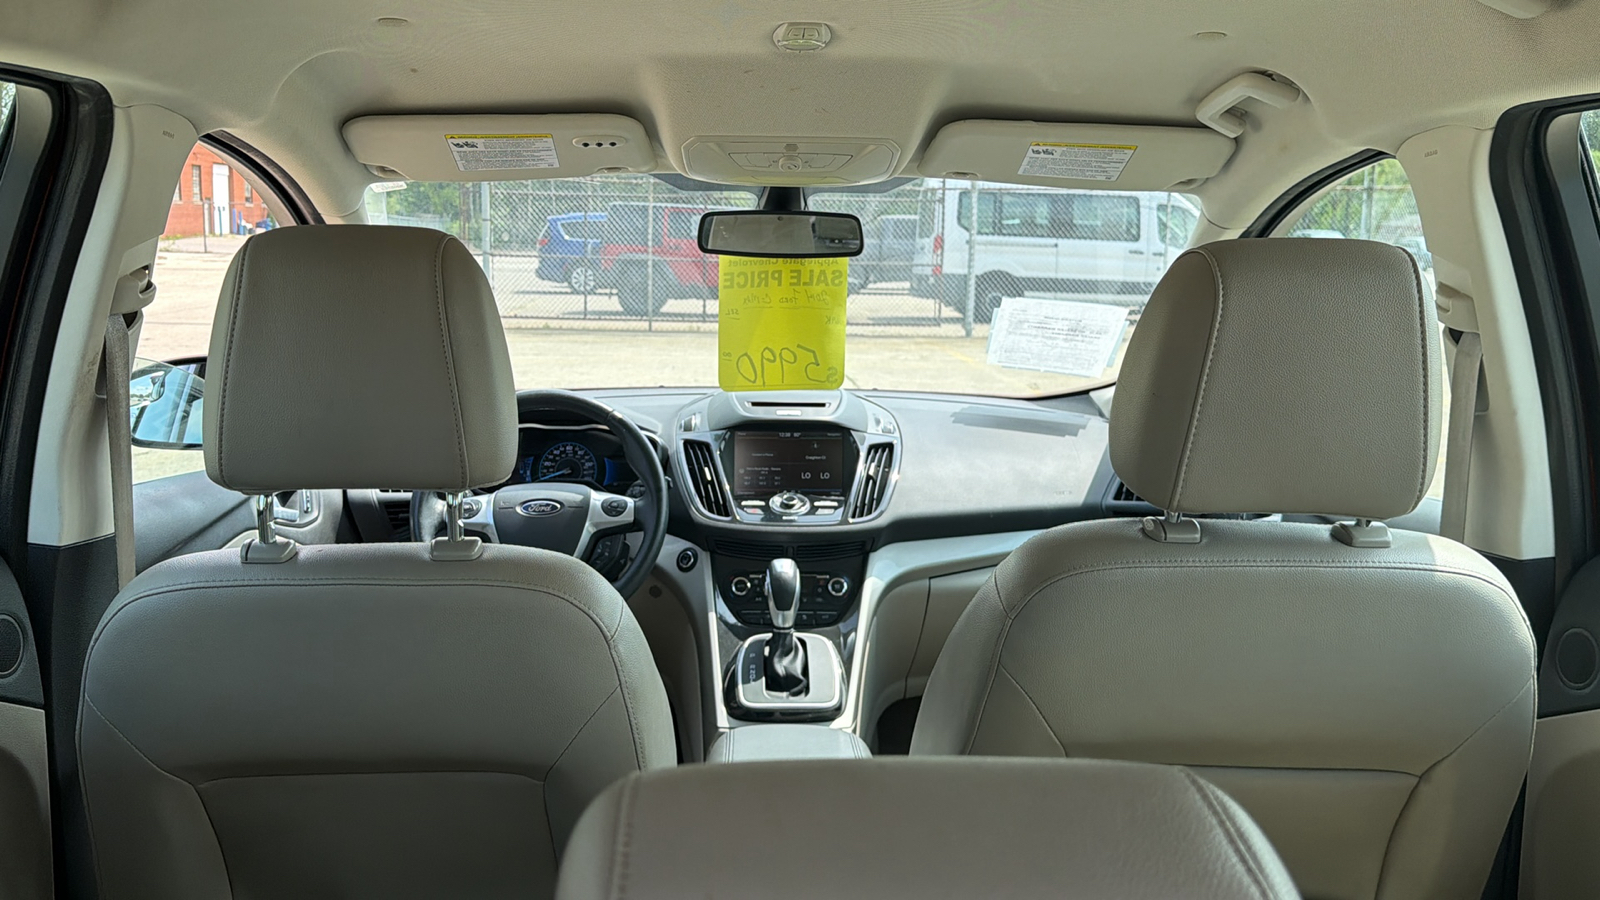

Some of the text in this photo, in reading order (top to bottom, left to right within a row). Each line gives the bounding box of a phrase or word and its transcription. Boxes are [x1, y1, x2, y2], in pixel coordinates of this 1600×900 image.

[801, 472, 830, 480] LO LO
[527, 503, 552, 512] Ford
